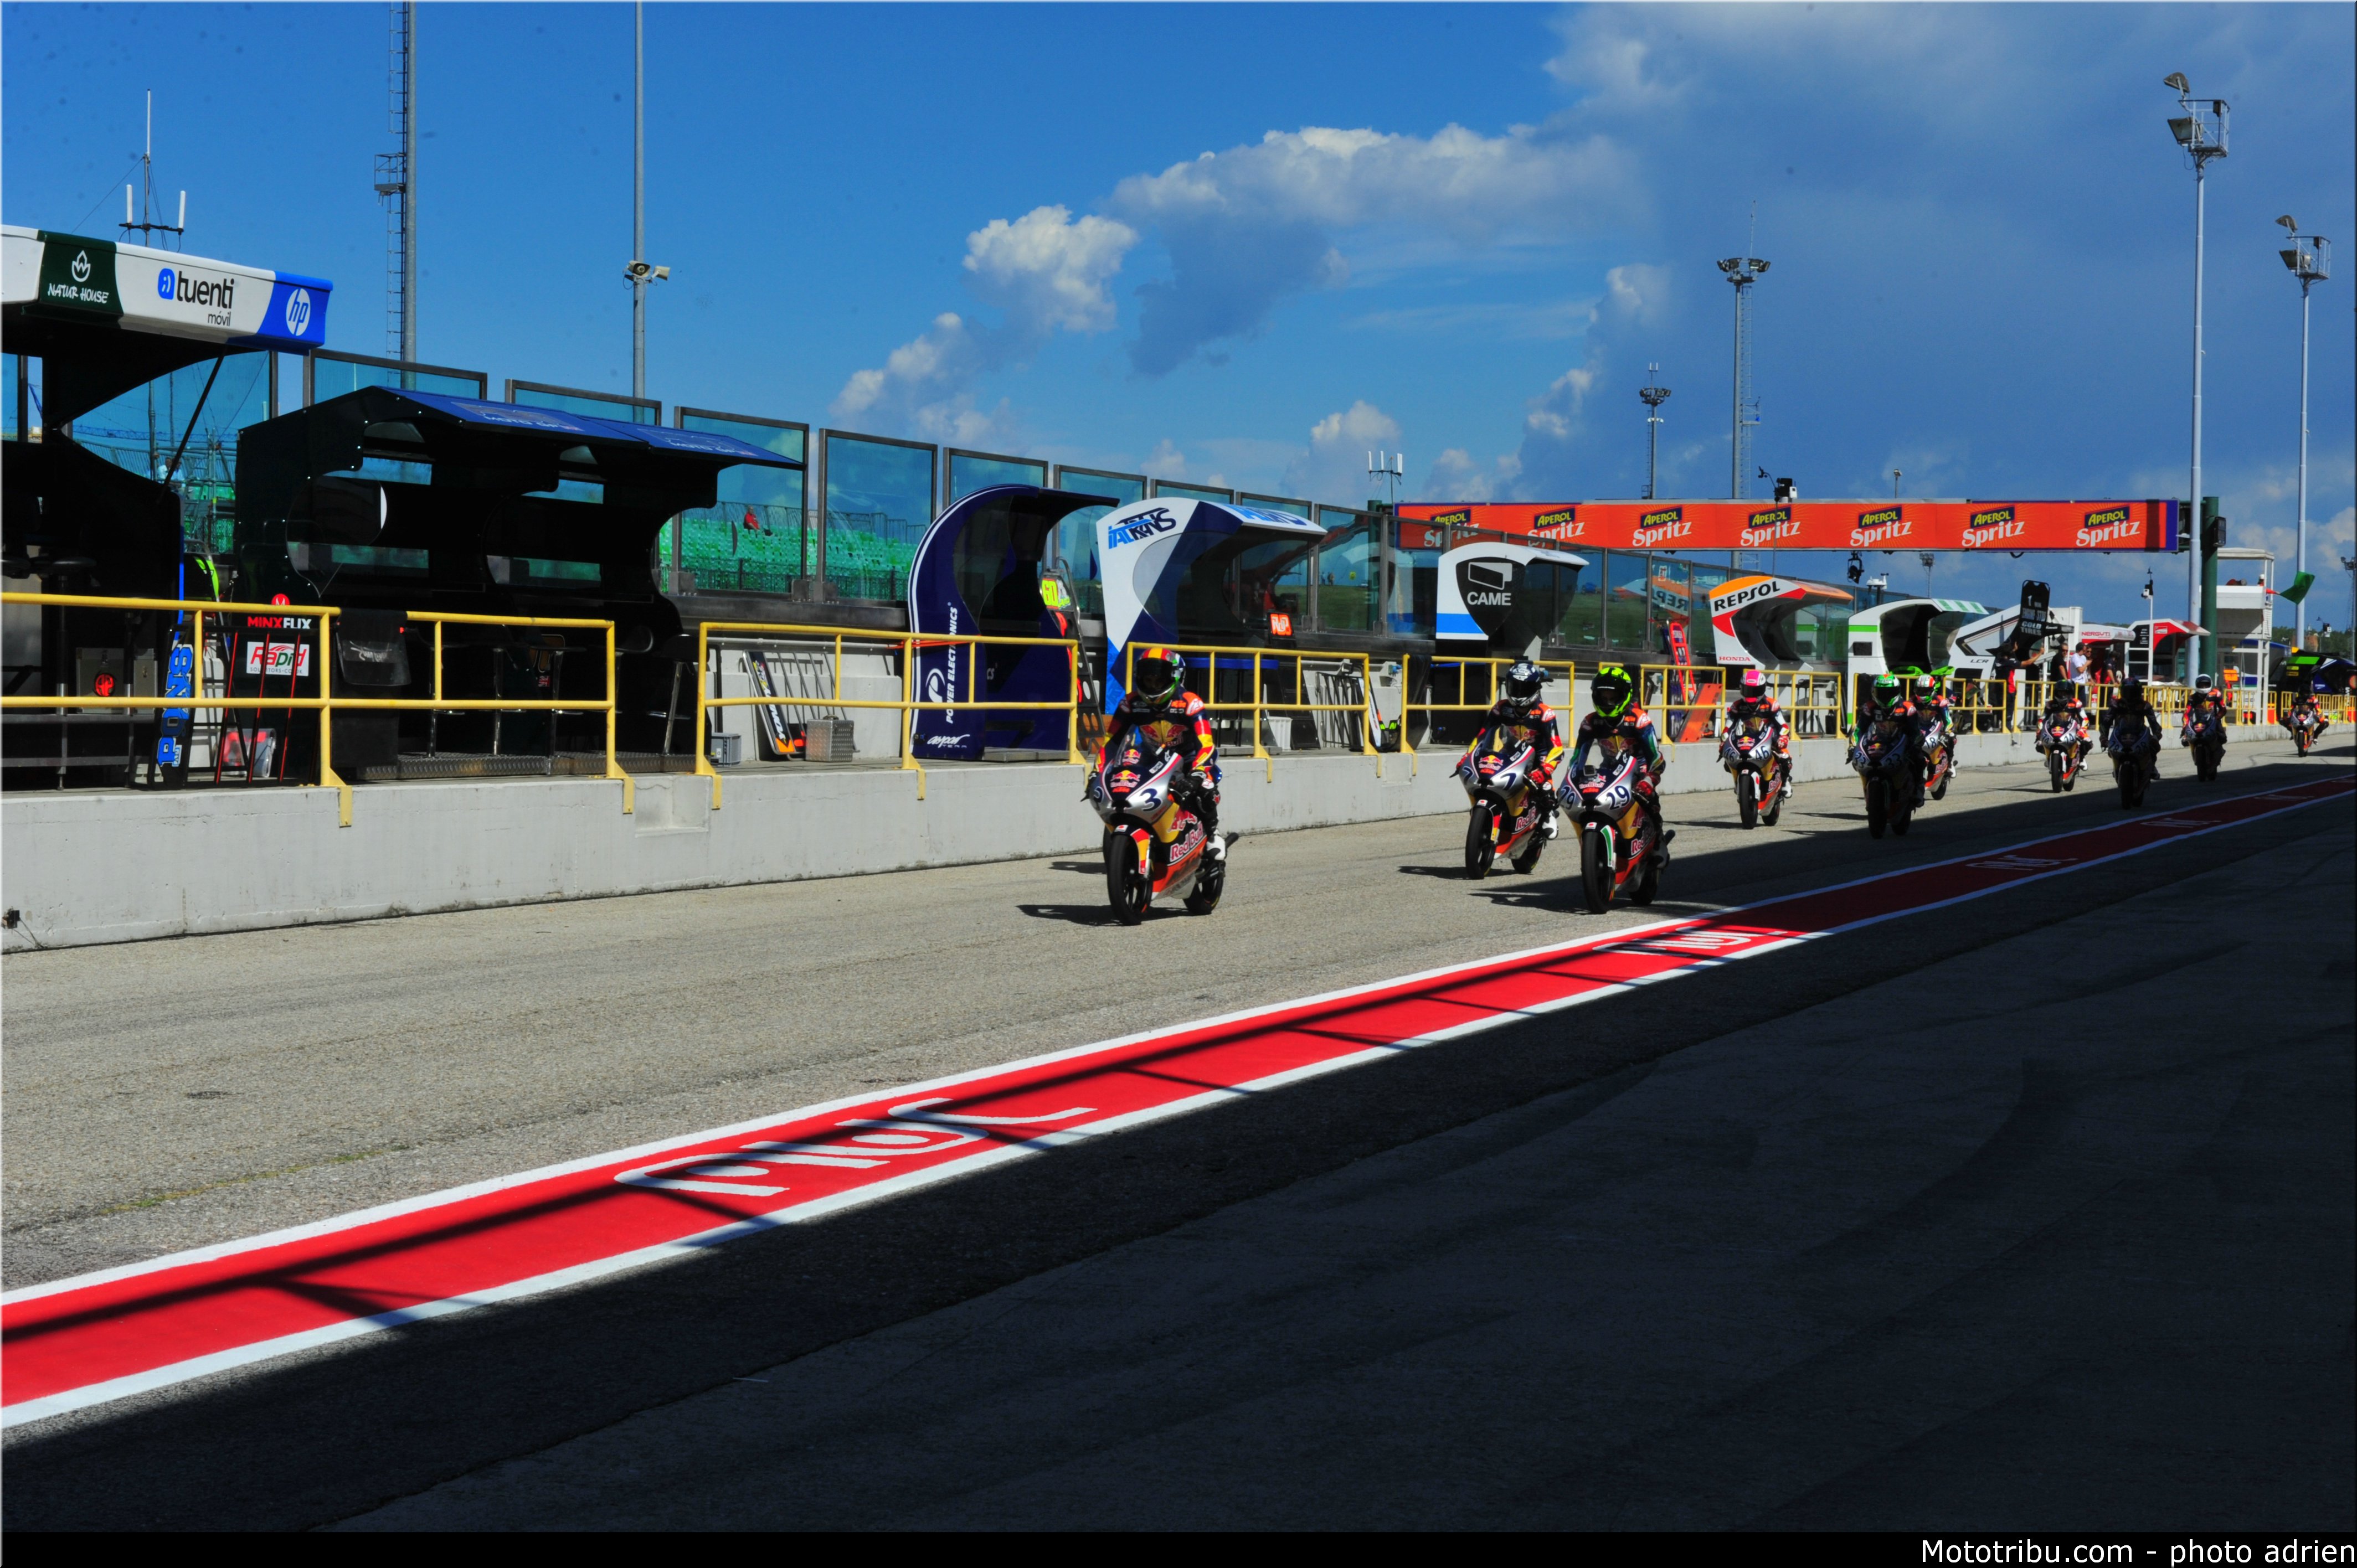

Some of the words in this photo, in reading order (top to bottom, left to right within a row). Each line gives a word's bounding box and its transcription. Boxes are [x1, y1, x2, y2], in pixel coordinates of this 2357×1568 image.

[48, 282, 78, 300] NATUR
[81, 286, 109, 304] HOUSE
[177, 271, 235, 310] tuenti
[208, 311, 231, 327] móvil
[288, 291, 308, 333] hp
[1537, 512, 1571, 527] APEROL
[1644, 511, 1679, 526] APEROL
[1752, 511, 1787, 526] APEROL
[1862, 510, 1898, 525] APEROL
[1974, 510, 2011, 525] APEROL
[2088, 510, 2126, 525] APEROL
[1632, 521, 1692, 546] Spritz
[1741, 521, 1800, 546] Spritz
[1850, 520, 1912, 546] Spritz
[1962, 520, 2025, 547] Spritz
[2076, 520, 2140, 546] Spritz
[1466, 591, 1511, 606] CAME
[1714, 581, 1780, 612] REPSOL
[248, 616, 312, 629] MINXFLIX
[2021, 621, 2042, 630] COLD
[250, 646, 307, 667] Rapid
[927, 734, 970, 749] aspar
[1756, 746, 1769, 761] 46
[1500, 772, 1517, 791] 7
[1139, 788, 1162, 812] 3
[1607, 785, 1632, 811] 29
[1515, 808, 1531, 831] Red
[1170, 834, 1190, 863] Red
[1188, 821, 1204, 849] Bull
